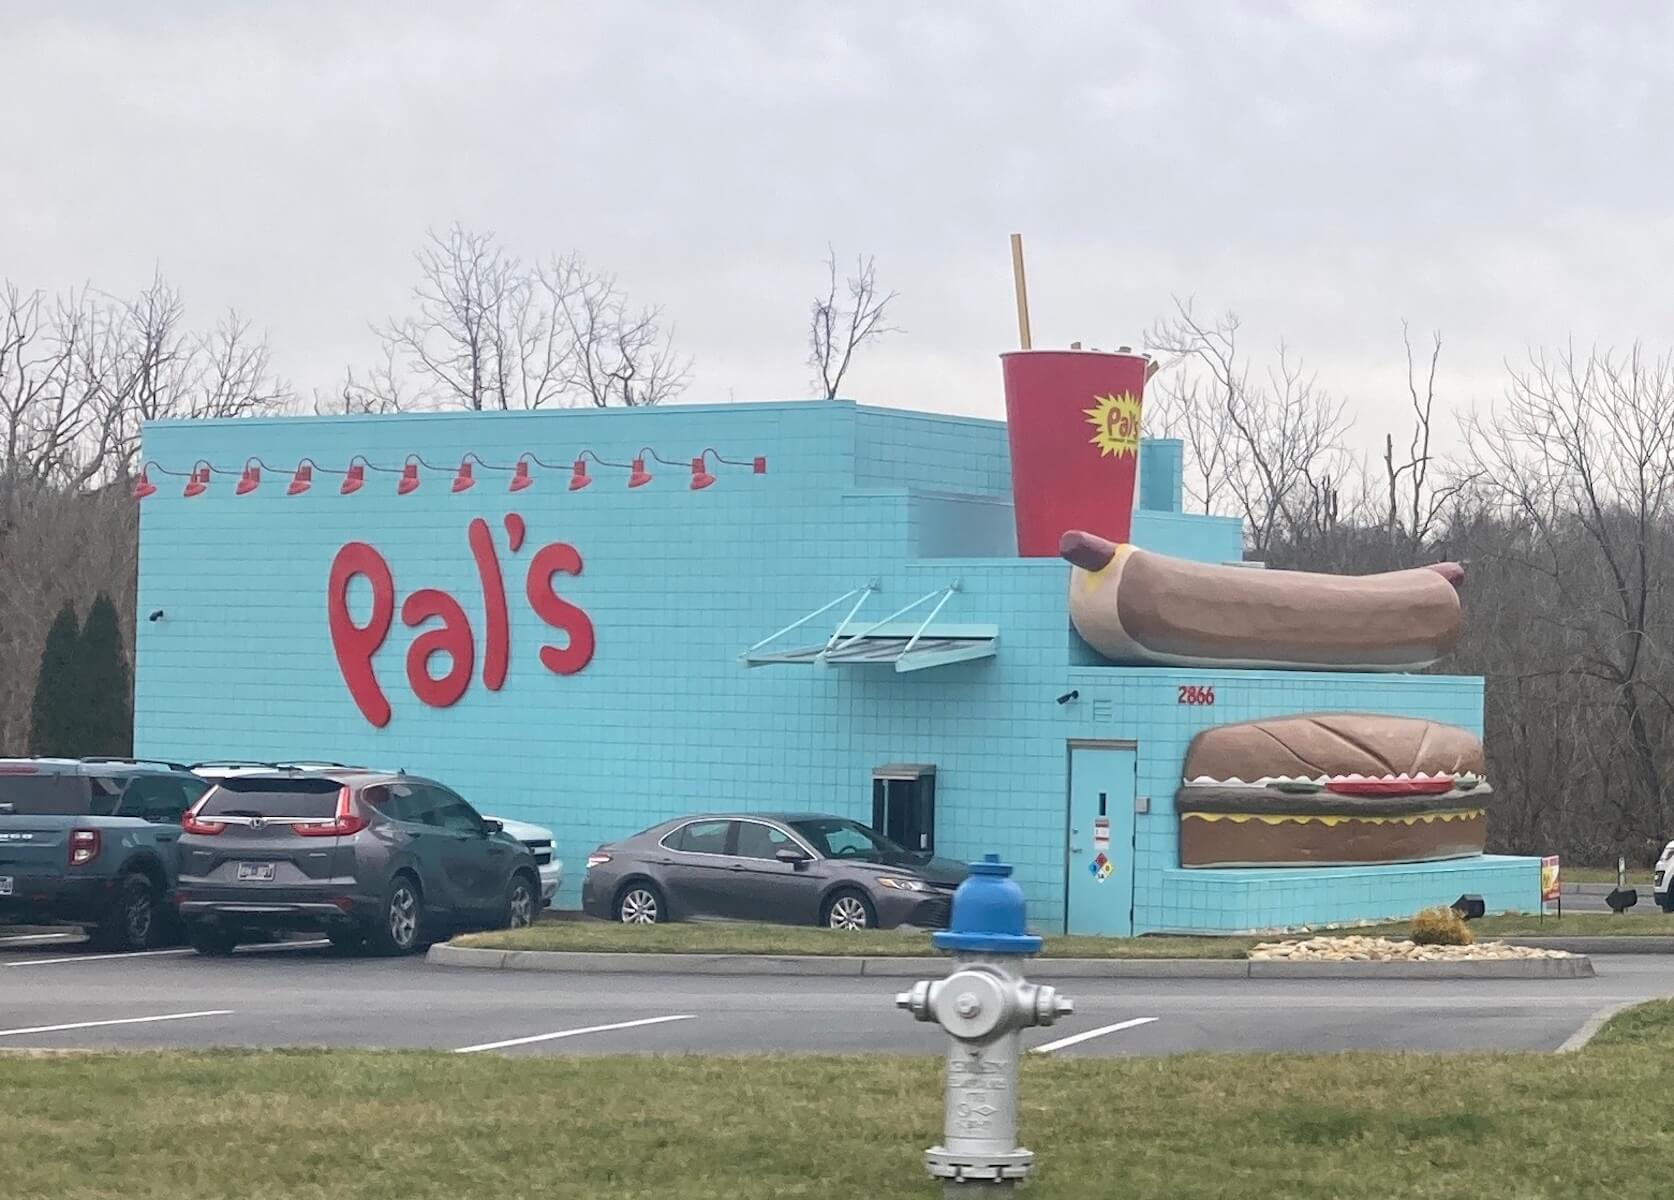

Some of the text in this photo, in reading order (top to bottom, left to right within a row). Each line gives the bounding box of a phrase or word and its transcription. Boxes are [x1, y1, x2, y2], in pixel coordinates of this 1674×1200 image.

[1107, 406, 1138, 440] Pal's
[328, 512, 595, 729] Pal's
[1178, 686, 1214, 705] 2866
